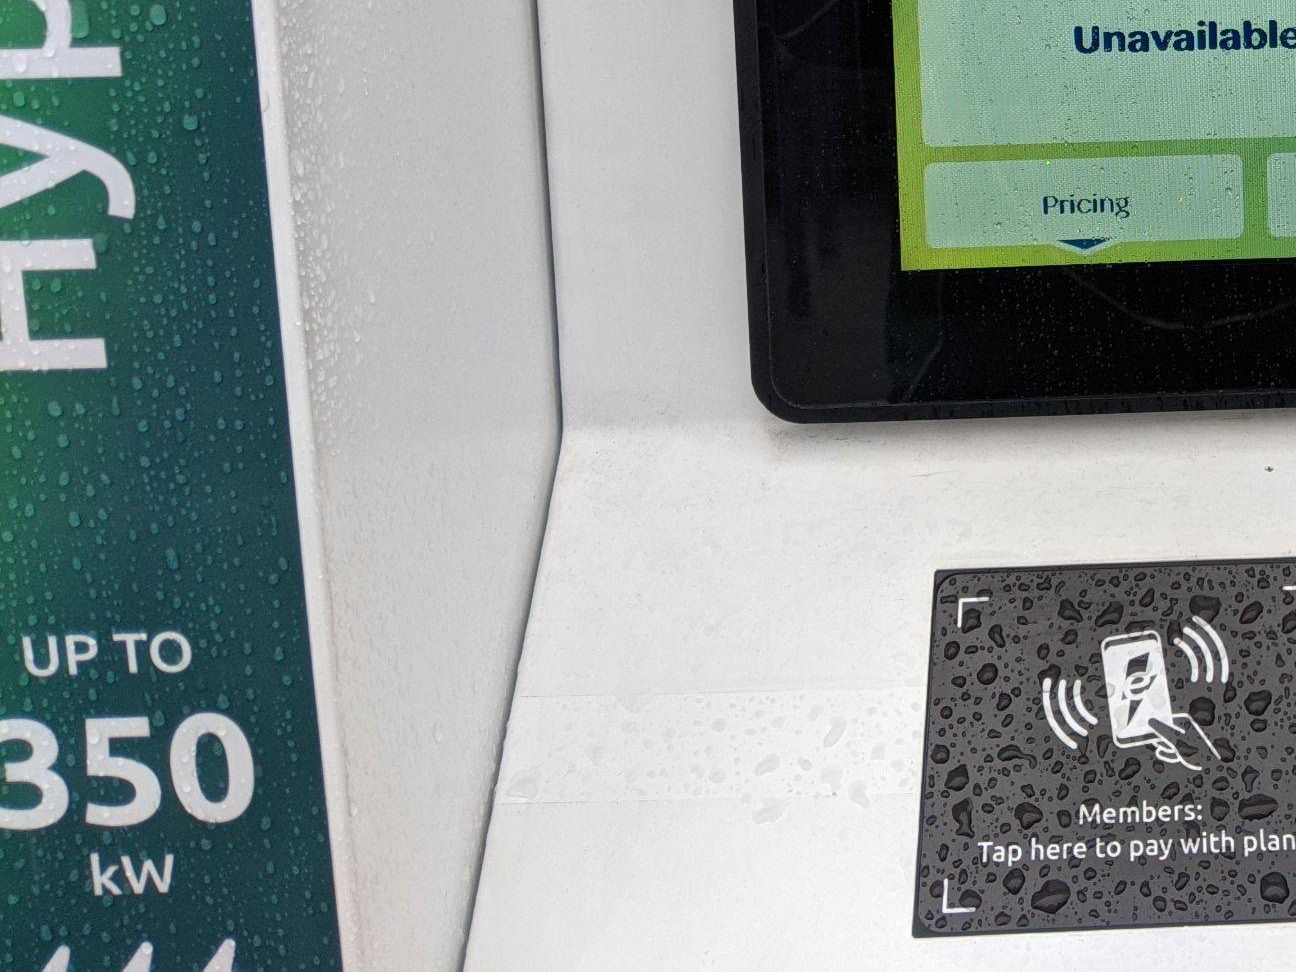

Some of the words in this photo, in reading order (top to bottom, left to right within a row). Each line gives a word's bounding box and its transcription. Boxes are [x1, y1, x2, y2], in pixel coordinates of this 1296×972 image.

[1042, 193, 1130, 219] Pricing
[21, 634, 98, 677] UP
[112, 631, 192, 674] TO
[0, 712, 255, 830] 350
[1079, 800, 1203, 825] Members:
[978, 842, 1022, 867] Tap
[1030, 837, 1086, 861] here
[1096, 837, 1122, 858] to
[1130, 836, 1173, 862] pay
[1180, 831, 1235, 855] with
[1243, 828, 1296, 857] plan
[90, 853, 174, 897] kW
